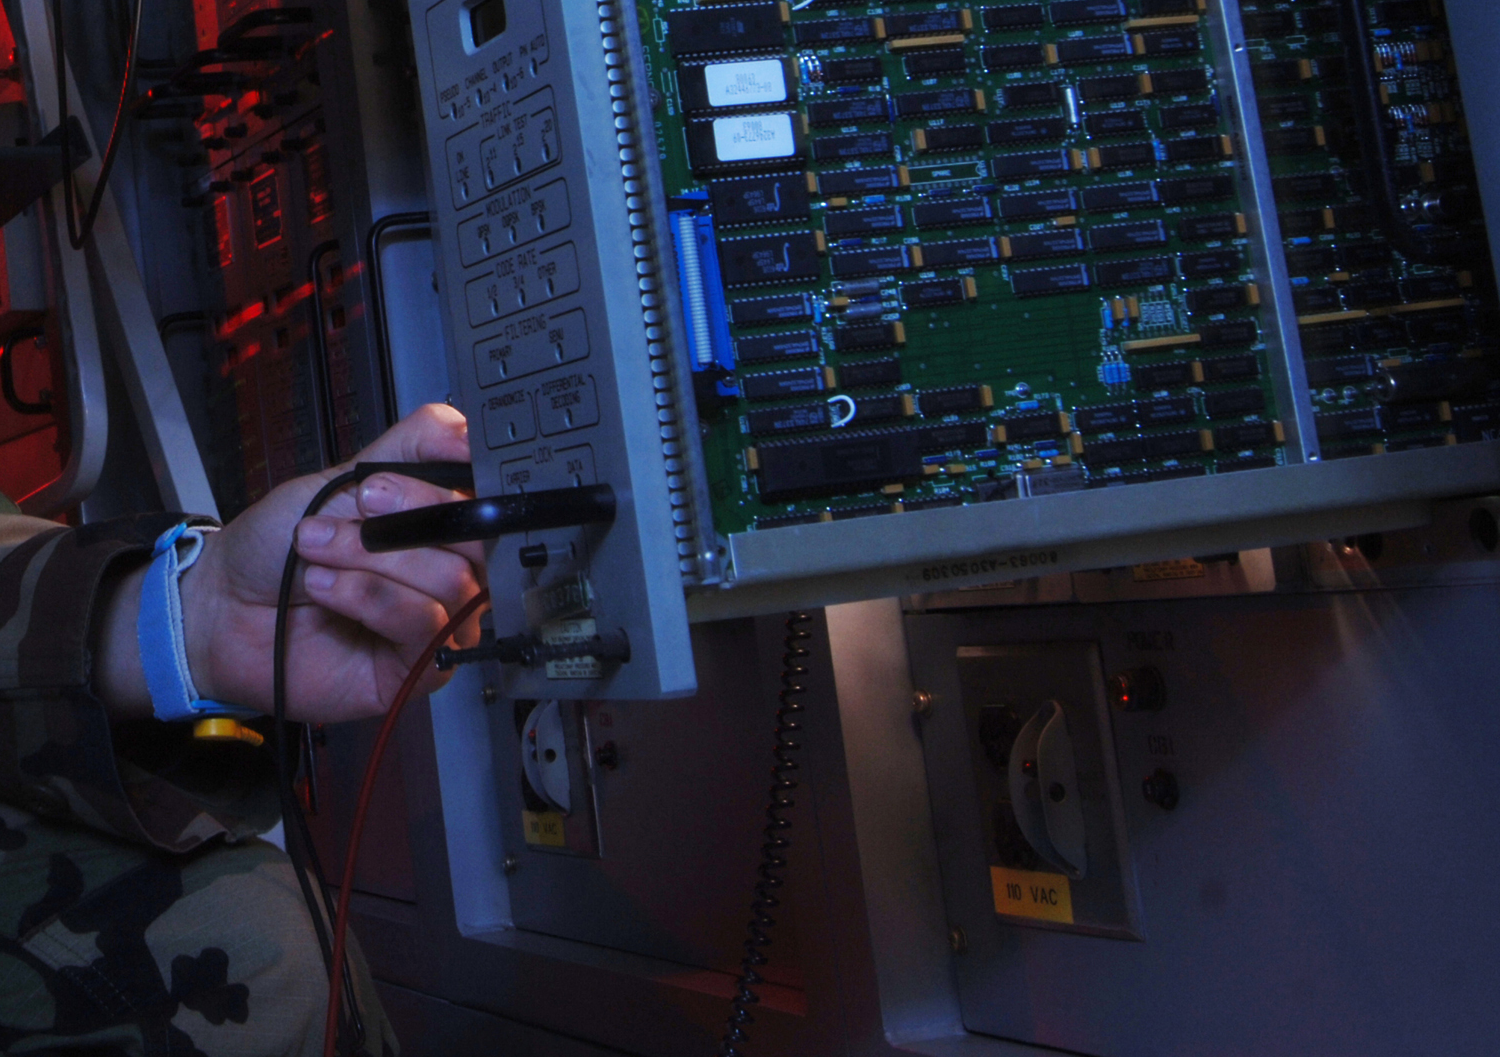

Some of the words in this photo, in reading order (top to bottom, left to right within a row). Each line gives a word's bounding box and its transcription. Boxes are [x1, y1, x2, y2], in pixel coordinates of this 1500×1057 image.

[440, 84, 460, 103] PSEUDO
[465, 68, 488, 90] CHANNEL
[492, 51, 513, 74] OUTPUT
[530, 33, 545, 51] AUTO
[480, 101, 512, 128] TRAFFIC
[497, 122, 512, 140] LINK
[513, 113, 528, 131] TEST
[456, 151, 464, 164] ON
[456, 166, 469, 183] LINE
[486, 184, 531, 218] MODULATION
[496, 257, 515, 279] CODE
[517, 248, 537, 270] RATE
[513, 274, 525, 289] 3/4
[537, 261, 557, 279] OTHER
[504, 313, 547, 341] FILTERING
[488, 344, 512, 362] PRIMARY
[541, 373, 586, 396] DIFFERENTIAL
[488, 389, 525, 411] DERANDOMIZE
[551, 390, 581, 410] DECODING
[533, 446, 554, 464] LOCK
[506, 469, 530, 486] CARRIER
[567, 459, 584, 474] DATA
[1127, 630, 1175, 651] POWER
[1006, 882, 1022, 901] 110
[1030, 886, 1057, 906] VAC
